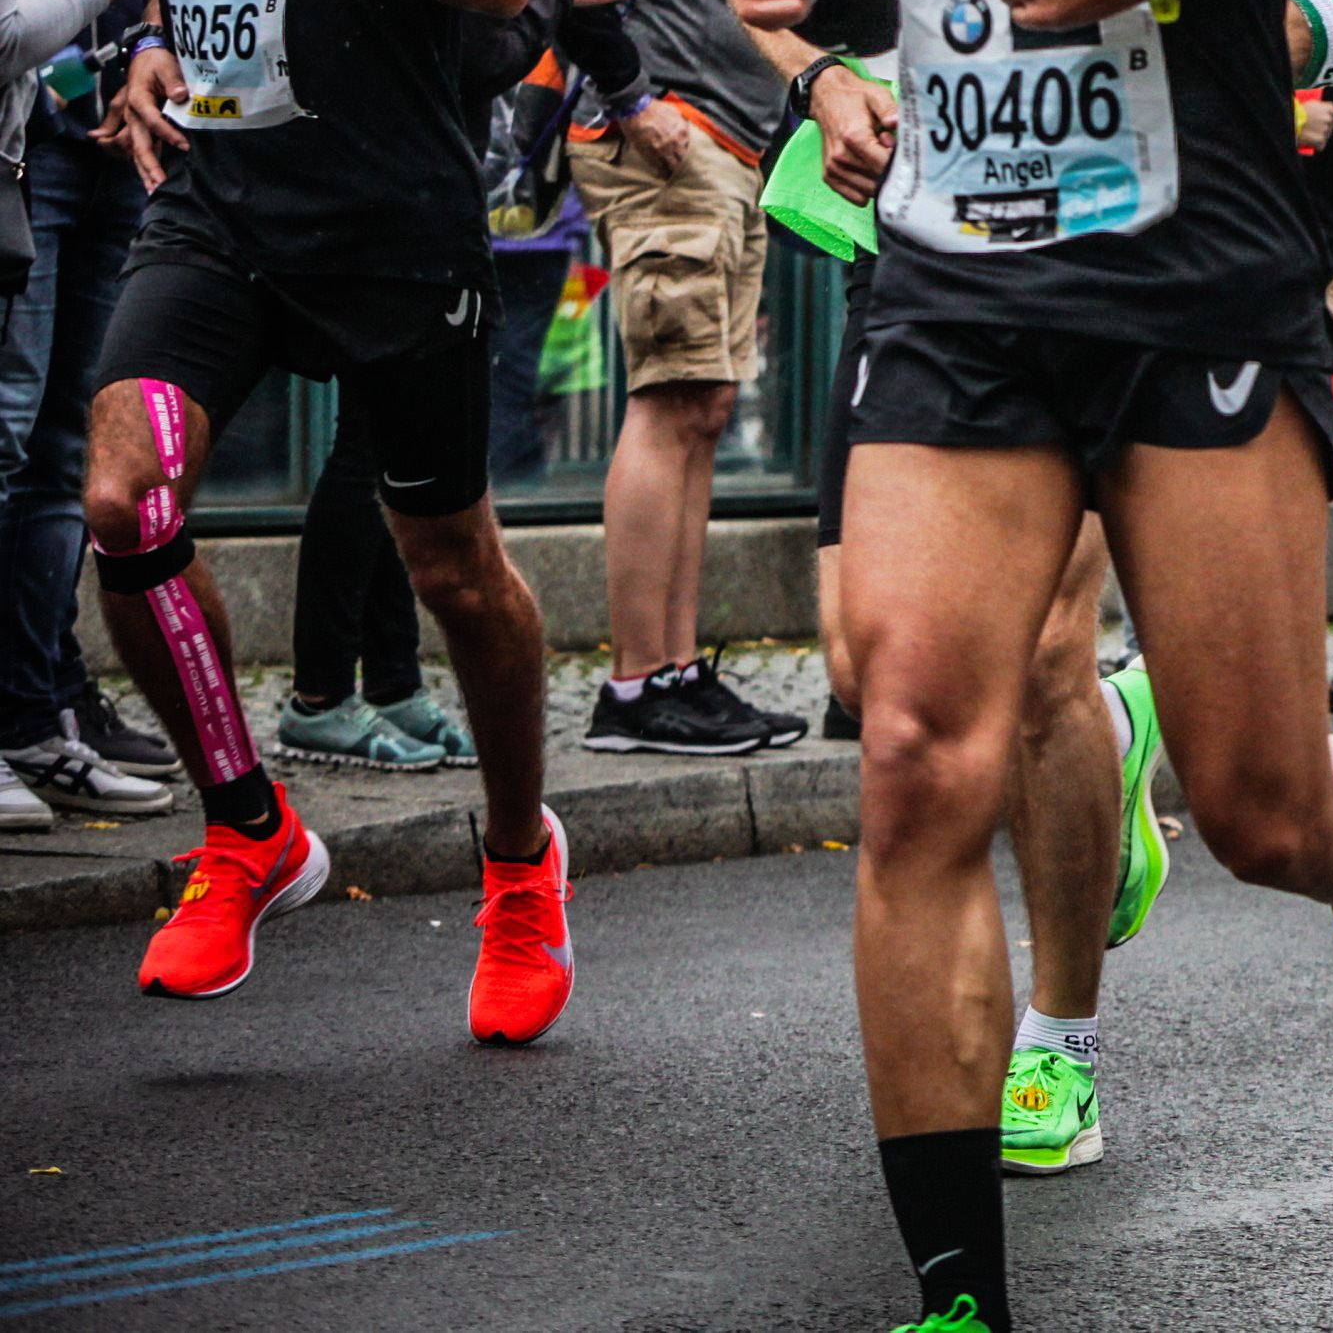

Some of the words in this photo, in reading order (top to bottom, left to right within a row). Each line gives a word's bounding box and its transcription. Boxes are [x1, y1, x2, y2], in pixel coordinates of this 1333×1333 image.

[1129, 49, 1148, 70] B
[927, 60, 1121, 153] 30406
[984, 154, 1054, 187] Angel
[1064, 1033, 1098, 1048] GO
